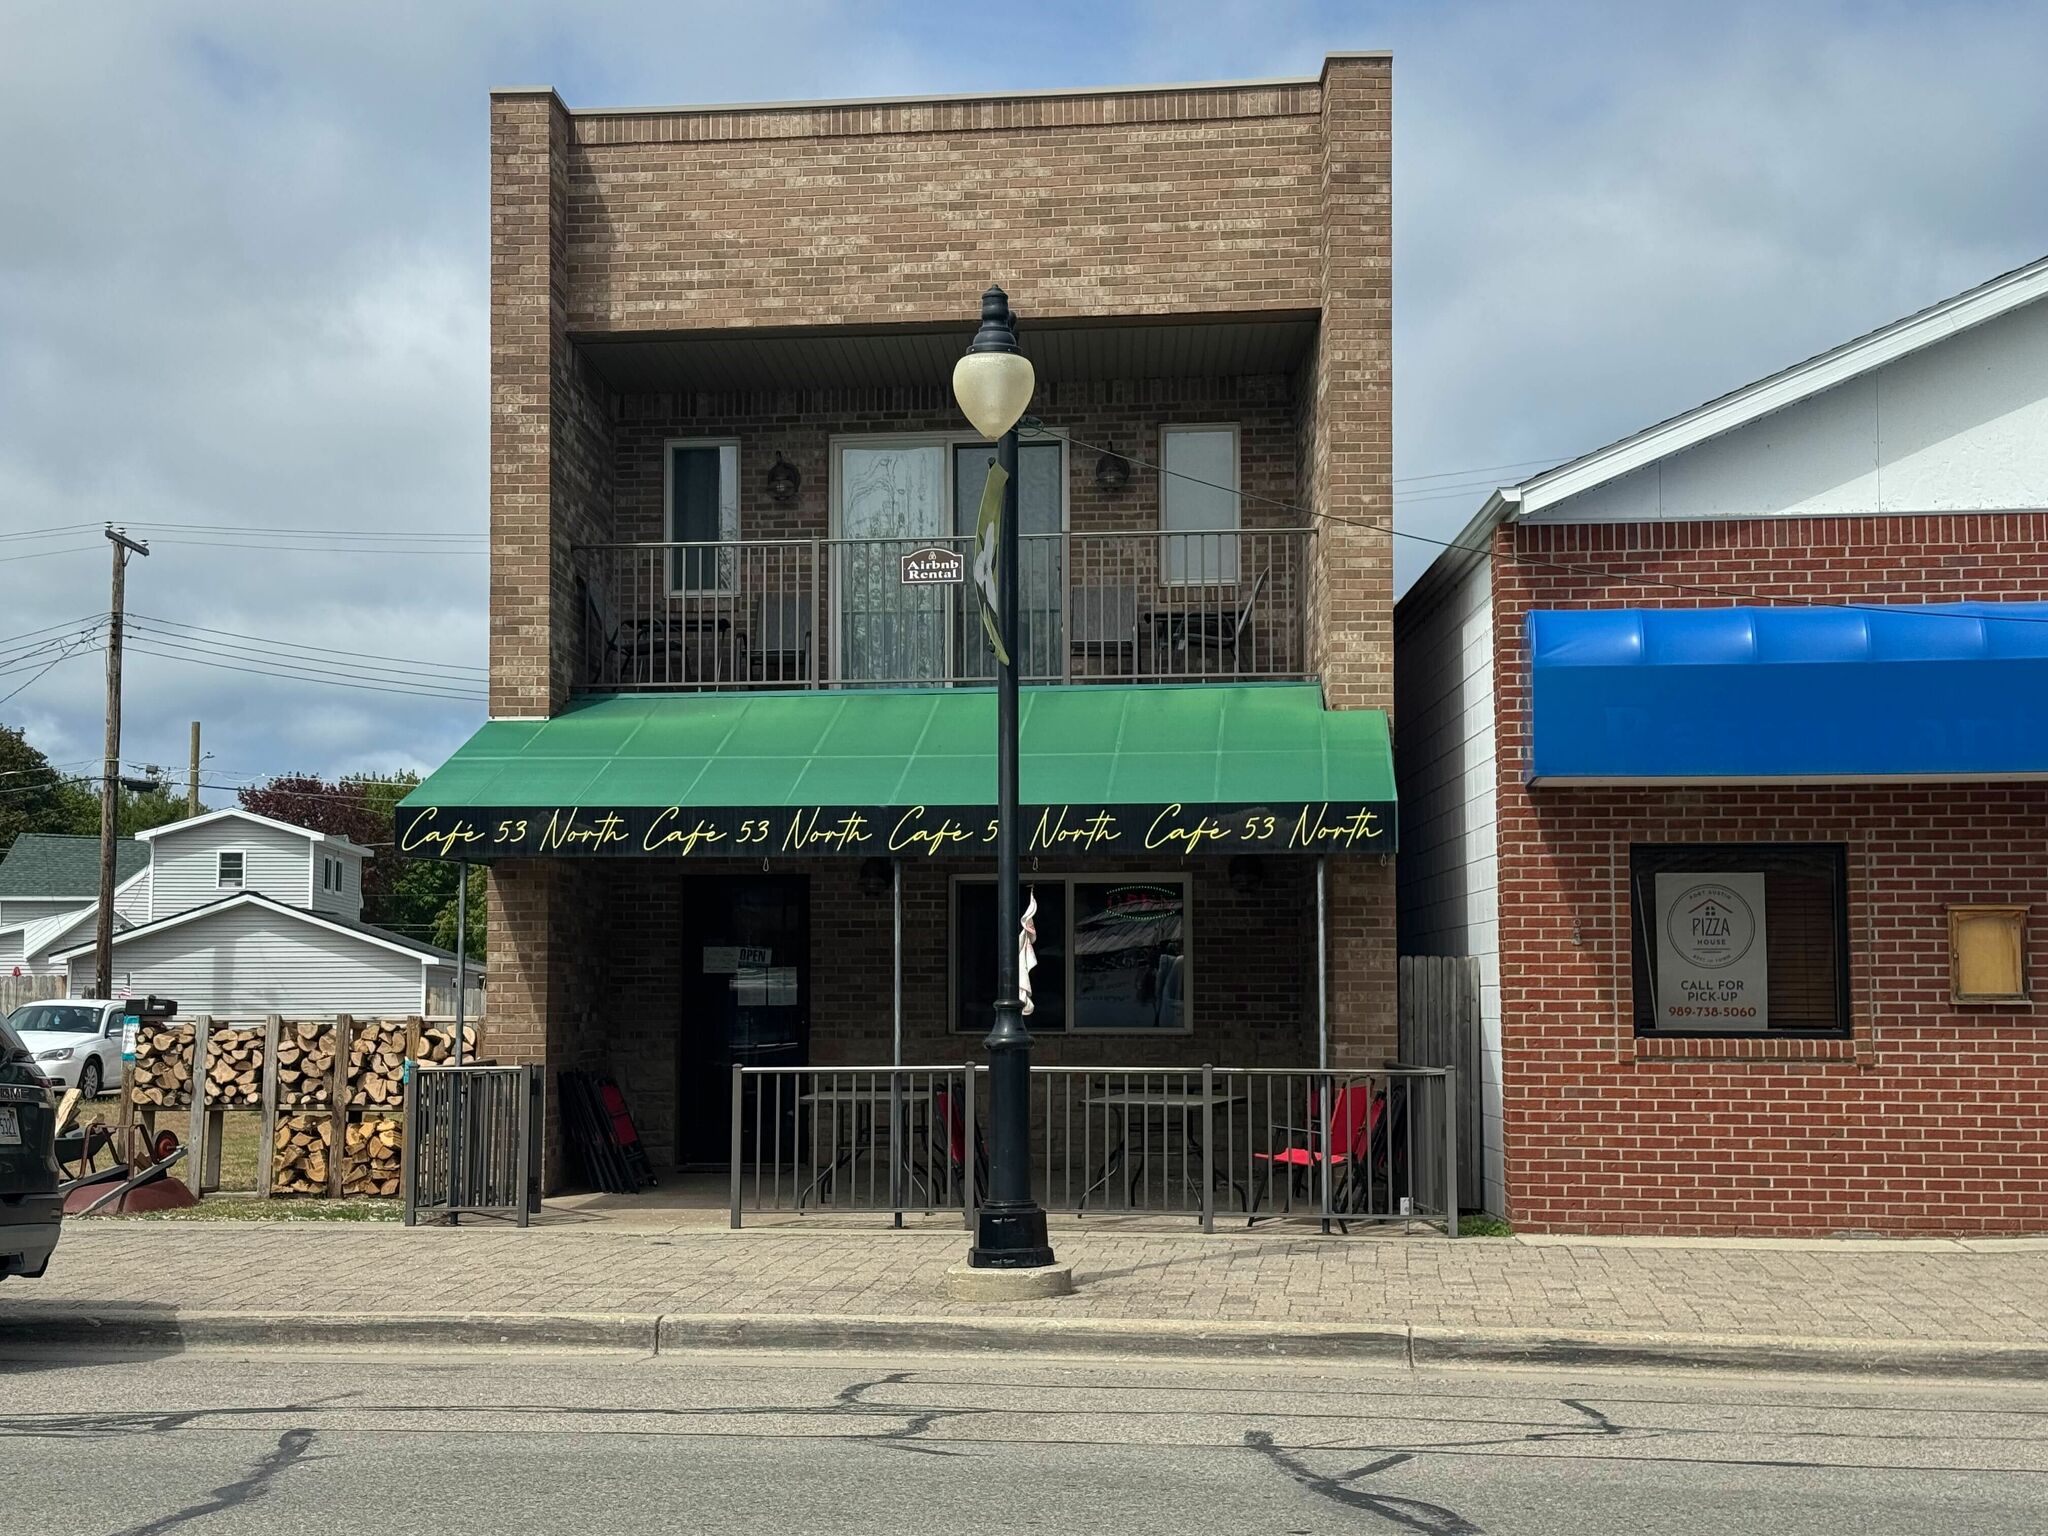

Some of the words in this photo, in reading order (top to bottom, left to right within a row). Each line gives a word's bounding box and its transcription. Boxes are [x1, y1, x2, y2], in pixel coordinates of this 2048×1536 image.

[907, 560, 959, 570] Airbnb
[909, 569, 957, 579] Rental
[401, 807, 485, 856] Café
[494, 819, 526, 843] 53
[539, 807, 629, 851] North
[643, 806, 727, 856] Café
[736, 819, 769, 843] 53
[782, 806, 872, 851] North
[888, 805, 974, 856] Café
[982, 818, 998, 842] 5
[1029, 805, 1122, 851] North
[1145, 803, 1231, 854] Café
[1240, 816, 1275, 840] 53
[1288, 803, 1383, 848] North
[1692, 917, 1731, 937] PIZZA
[1697, 938, 1726, 946] HOUSE
[740, 948, 766, 962] OPEN
[1680, 980, 1714, 991] CALL
[1718, 980, 1744, 991] FOR
[1687, 991, 1738, 1002] PICK-UP
[1668, 1006, 1757, 1018] 989-738-5060
